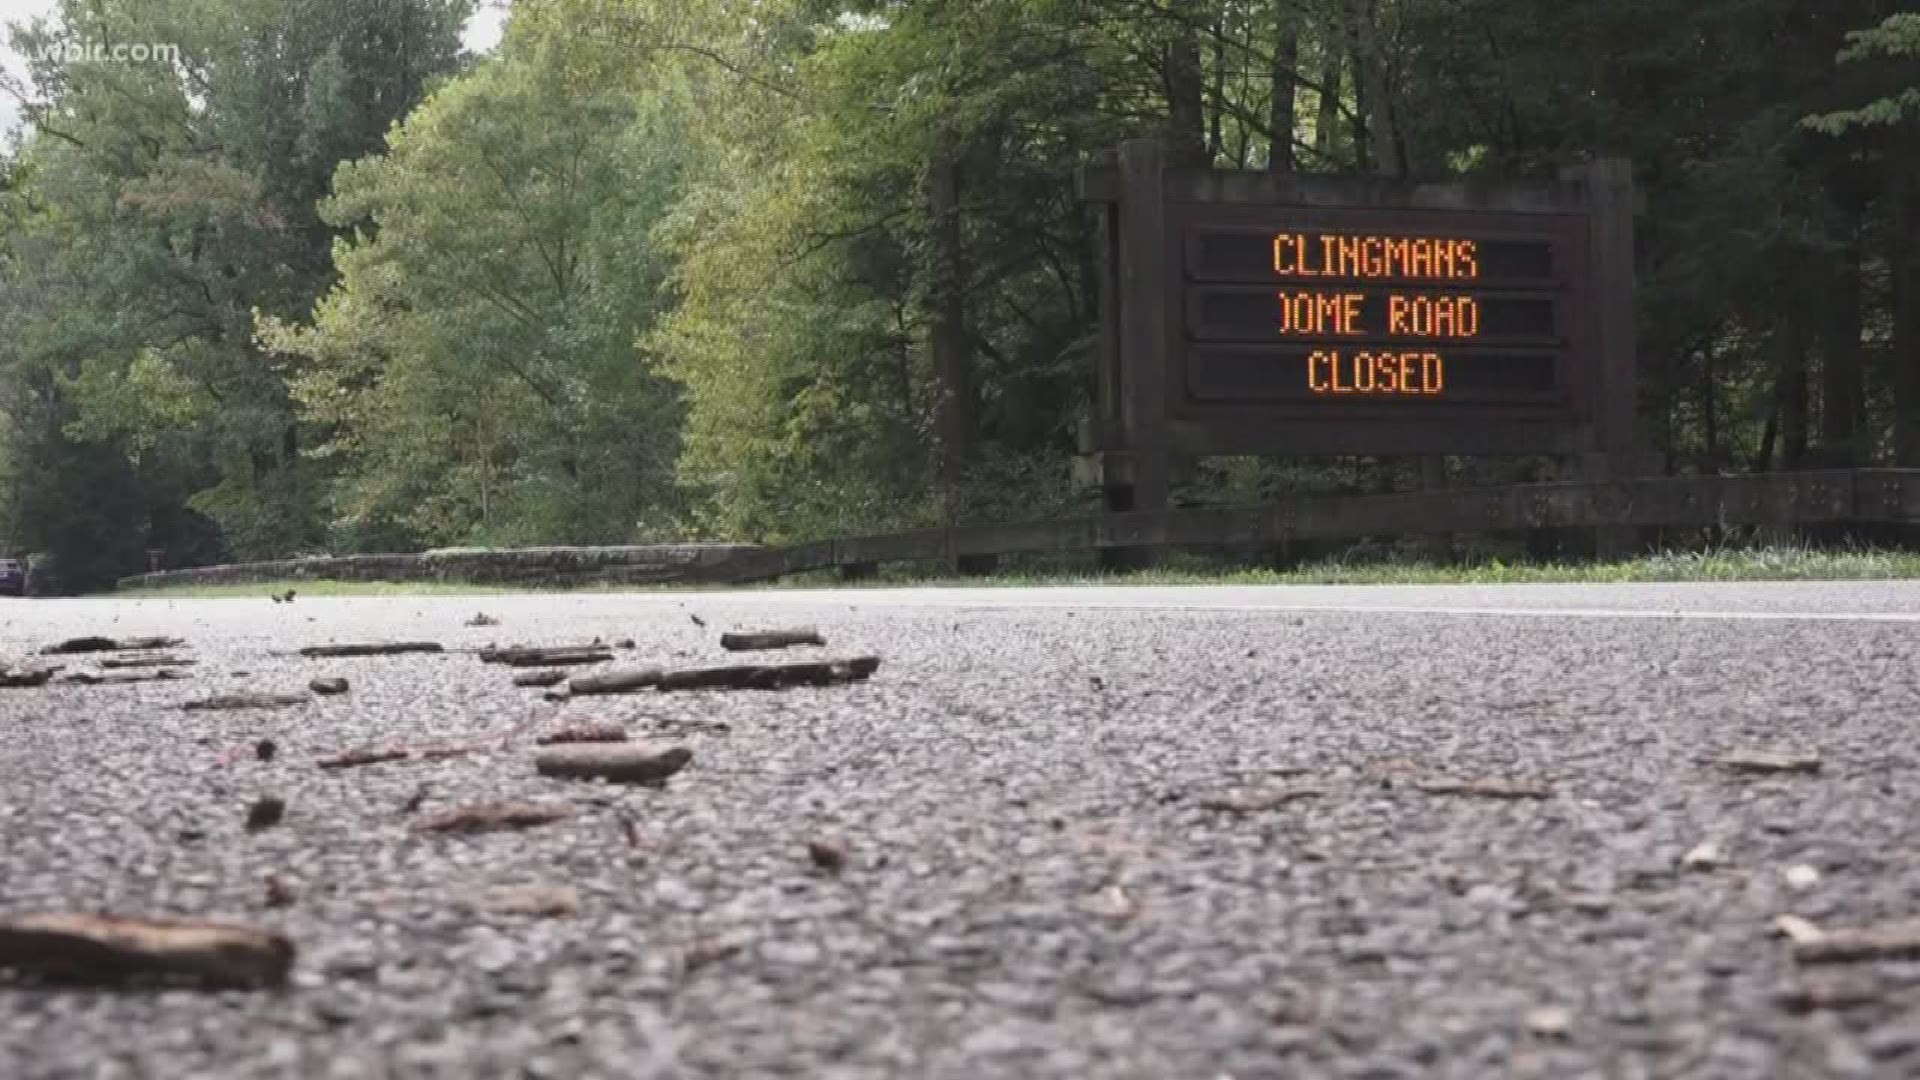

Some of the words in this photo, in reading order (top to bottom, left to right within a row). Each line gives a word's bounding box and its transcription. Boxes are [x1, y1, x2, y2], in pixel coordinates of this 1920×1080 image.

[1273, 234, 1477, 277] CLINGMANS
[1388, 295, 1477, 337] ROAD
[1307, 351, 1443, 393] CLOSED
